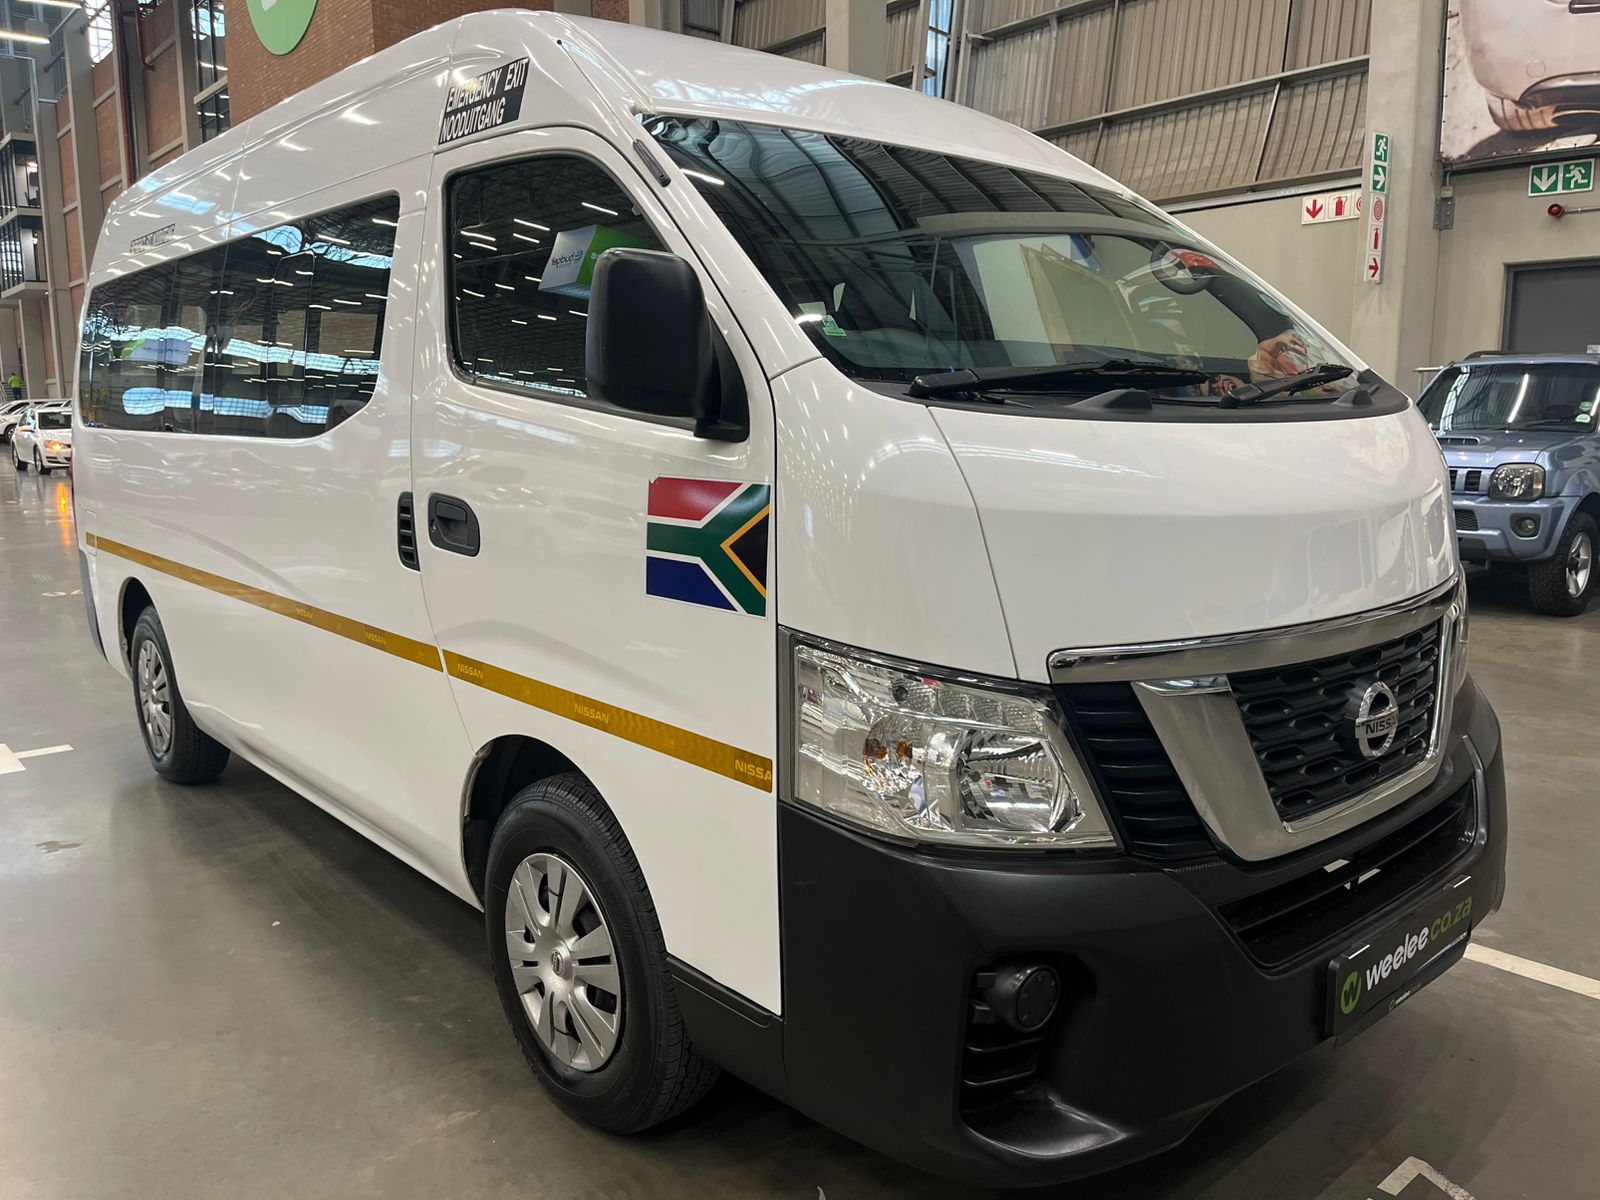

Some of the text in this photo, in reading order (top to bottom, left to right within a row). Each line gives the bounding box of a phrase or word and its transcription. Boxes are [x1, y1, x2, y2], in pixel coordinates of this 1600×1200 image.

[504, 58, 529, 92] EXIT
[440, 96, 506, 143] NOODUITGANG
[457, 662, 484, 680] NISSAN
[574, 703, 609, 725] NISSAN
[1365, 718, 1393, 735] NISS
